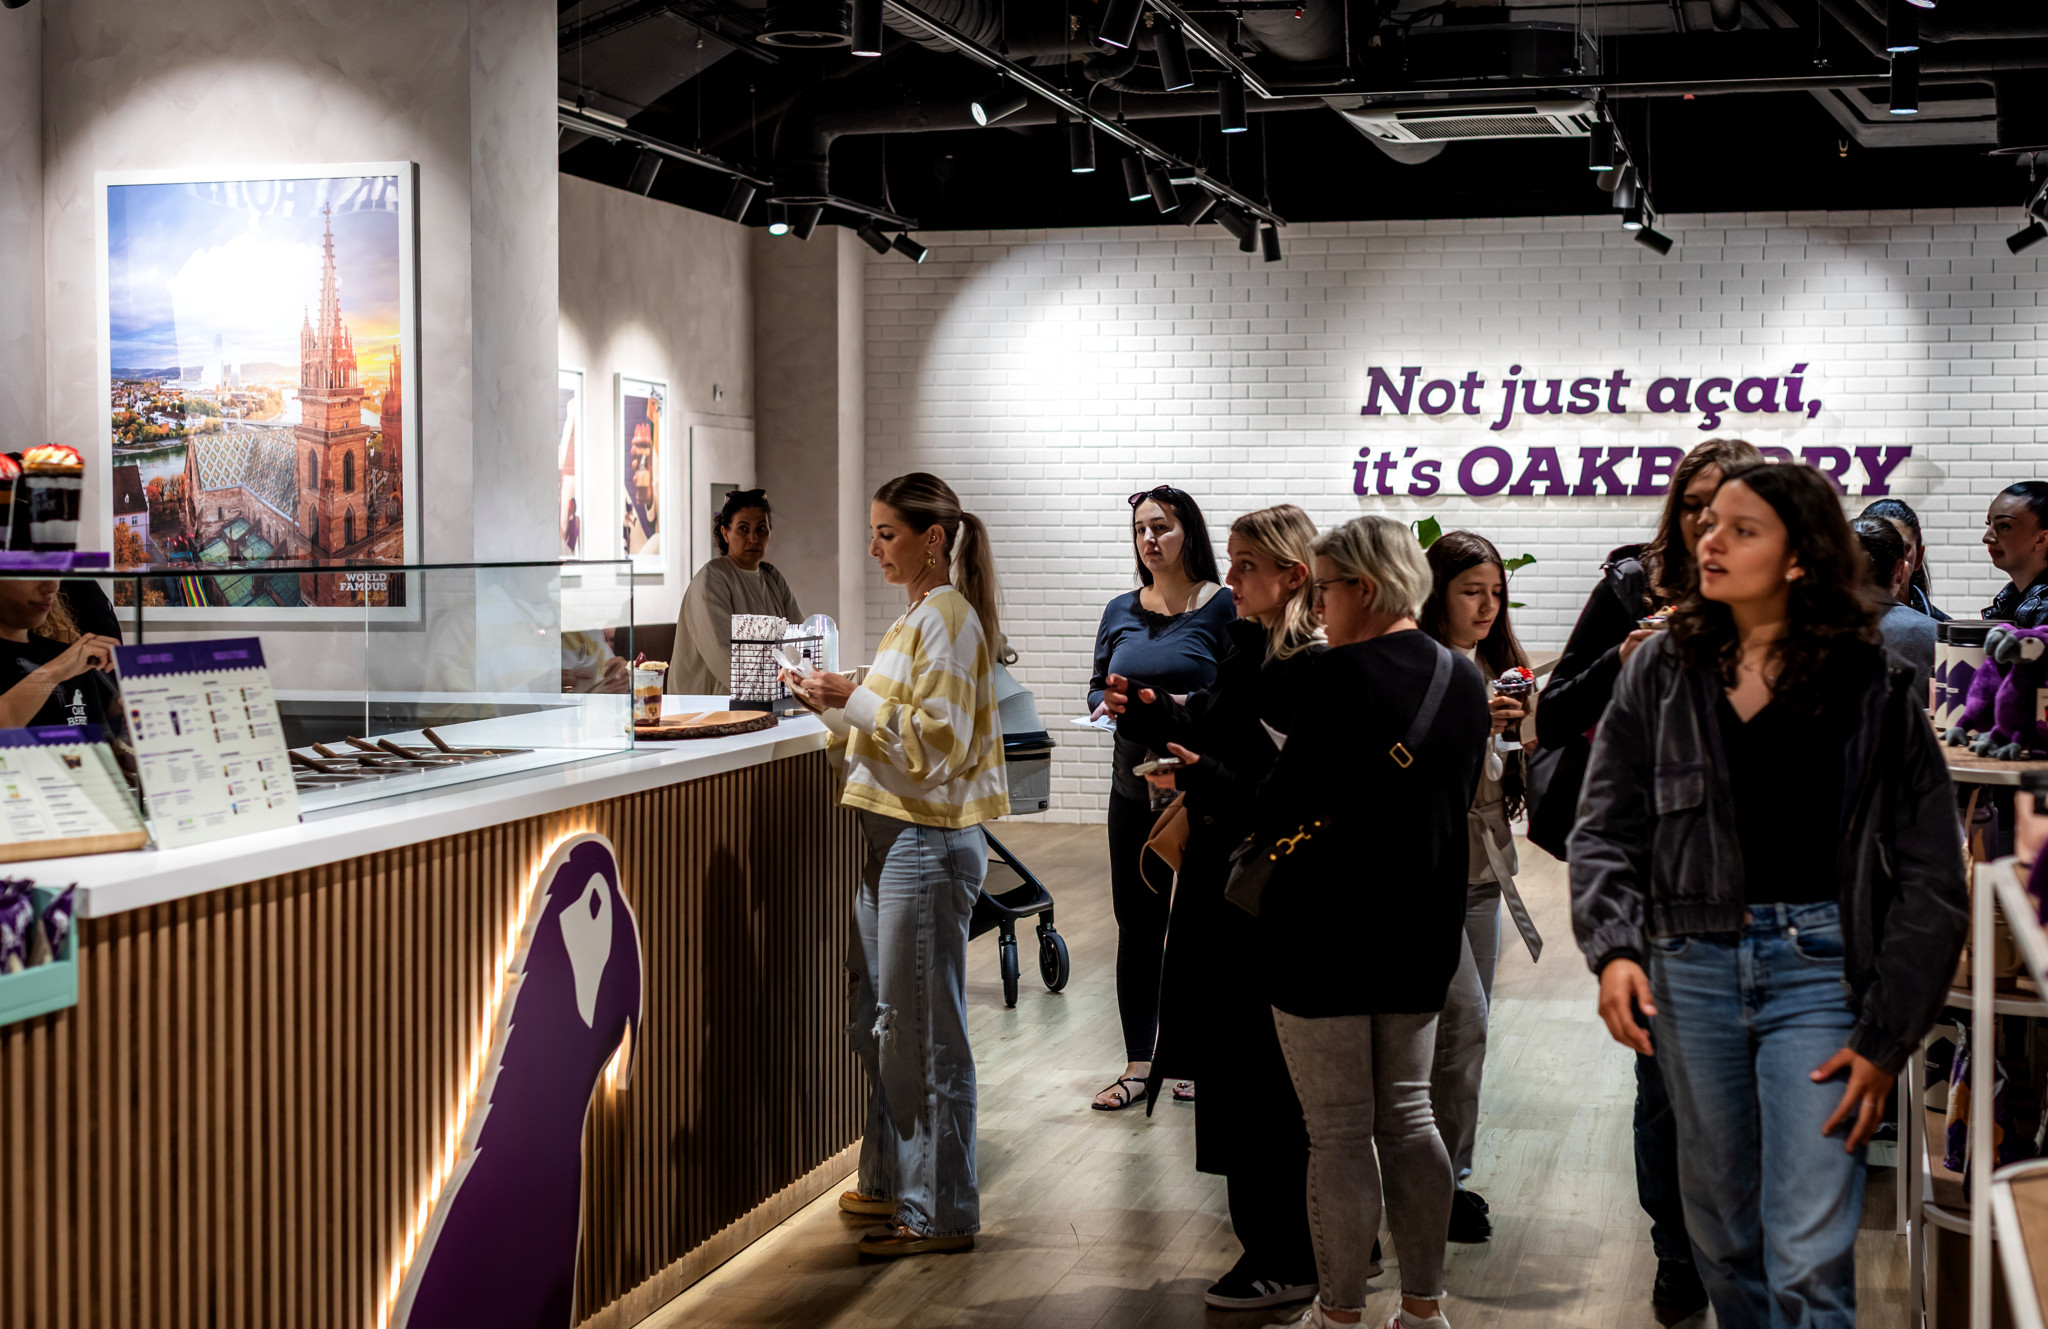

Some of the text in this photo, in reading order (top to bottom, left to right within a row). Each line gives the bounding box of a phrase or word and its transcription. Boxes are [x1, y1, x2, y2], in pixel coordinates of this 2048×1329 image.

[1361, 363, 1822, 431] Not just açaí,
[1457, 446, 1913, 497] OAKBRY
[345, 573, 387, 582] WORLD
[340, 582, 387, 592] FAMOUS
[72, 706, 86, 716] OAK
[66, 716, 88, 726] BERR
